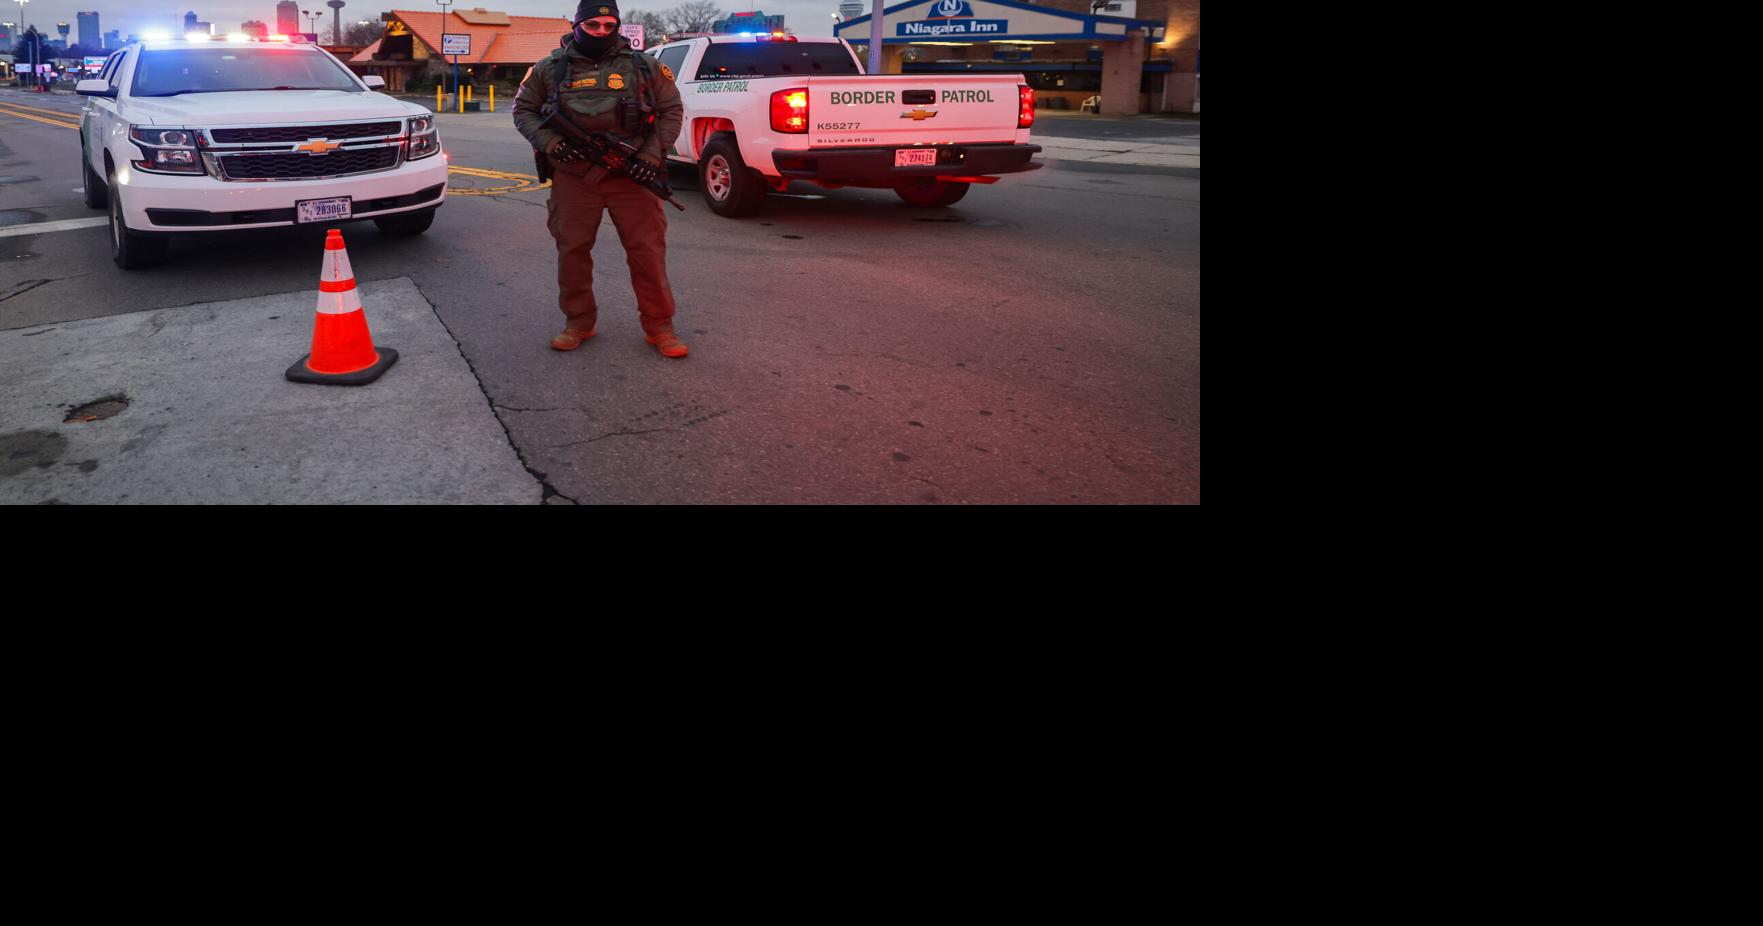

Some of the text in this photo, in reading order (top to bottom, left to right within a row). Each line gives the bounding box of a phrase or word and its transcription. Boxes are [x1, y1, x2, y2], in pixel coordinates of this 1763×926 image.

[943, 0, 957, 11] N
[905, 20, 998, 35] Niagara Inn
[697, 80, 749, 94] BORDER PATROL
[830, 89, 995, 105] BORDER PATROL
[817, 122, 861, 130] K55277
[315, 203, 347, 216] 283066
